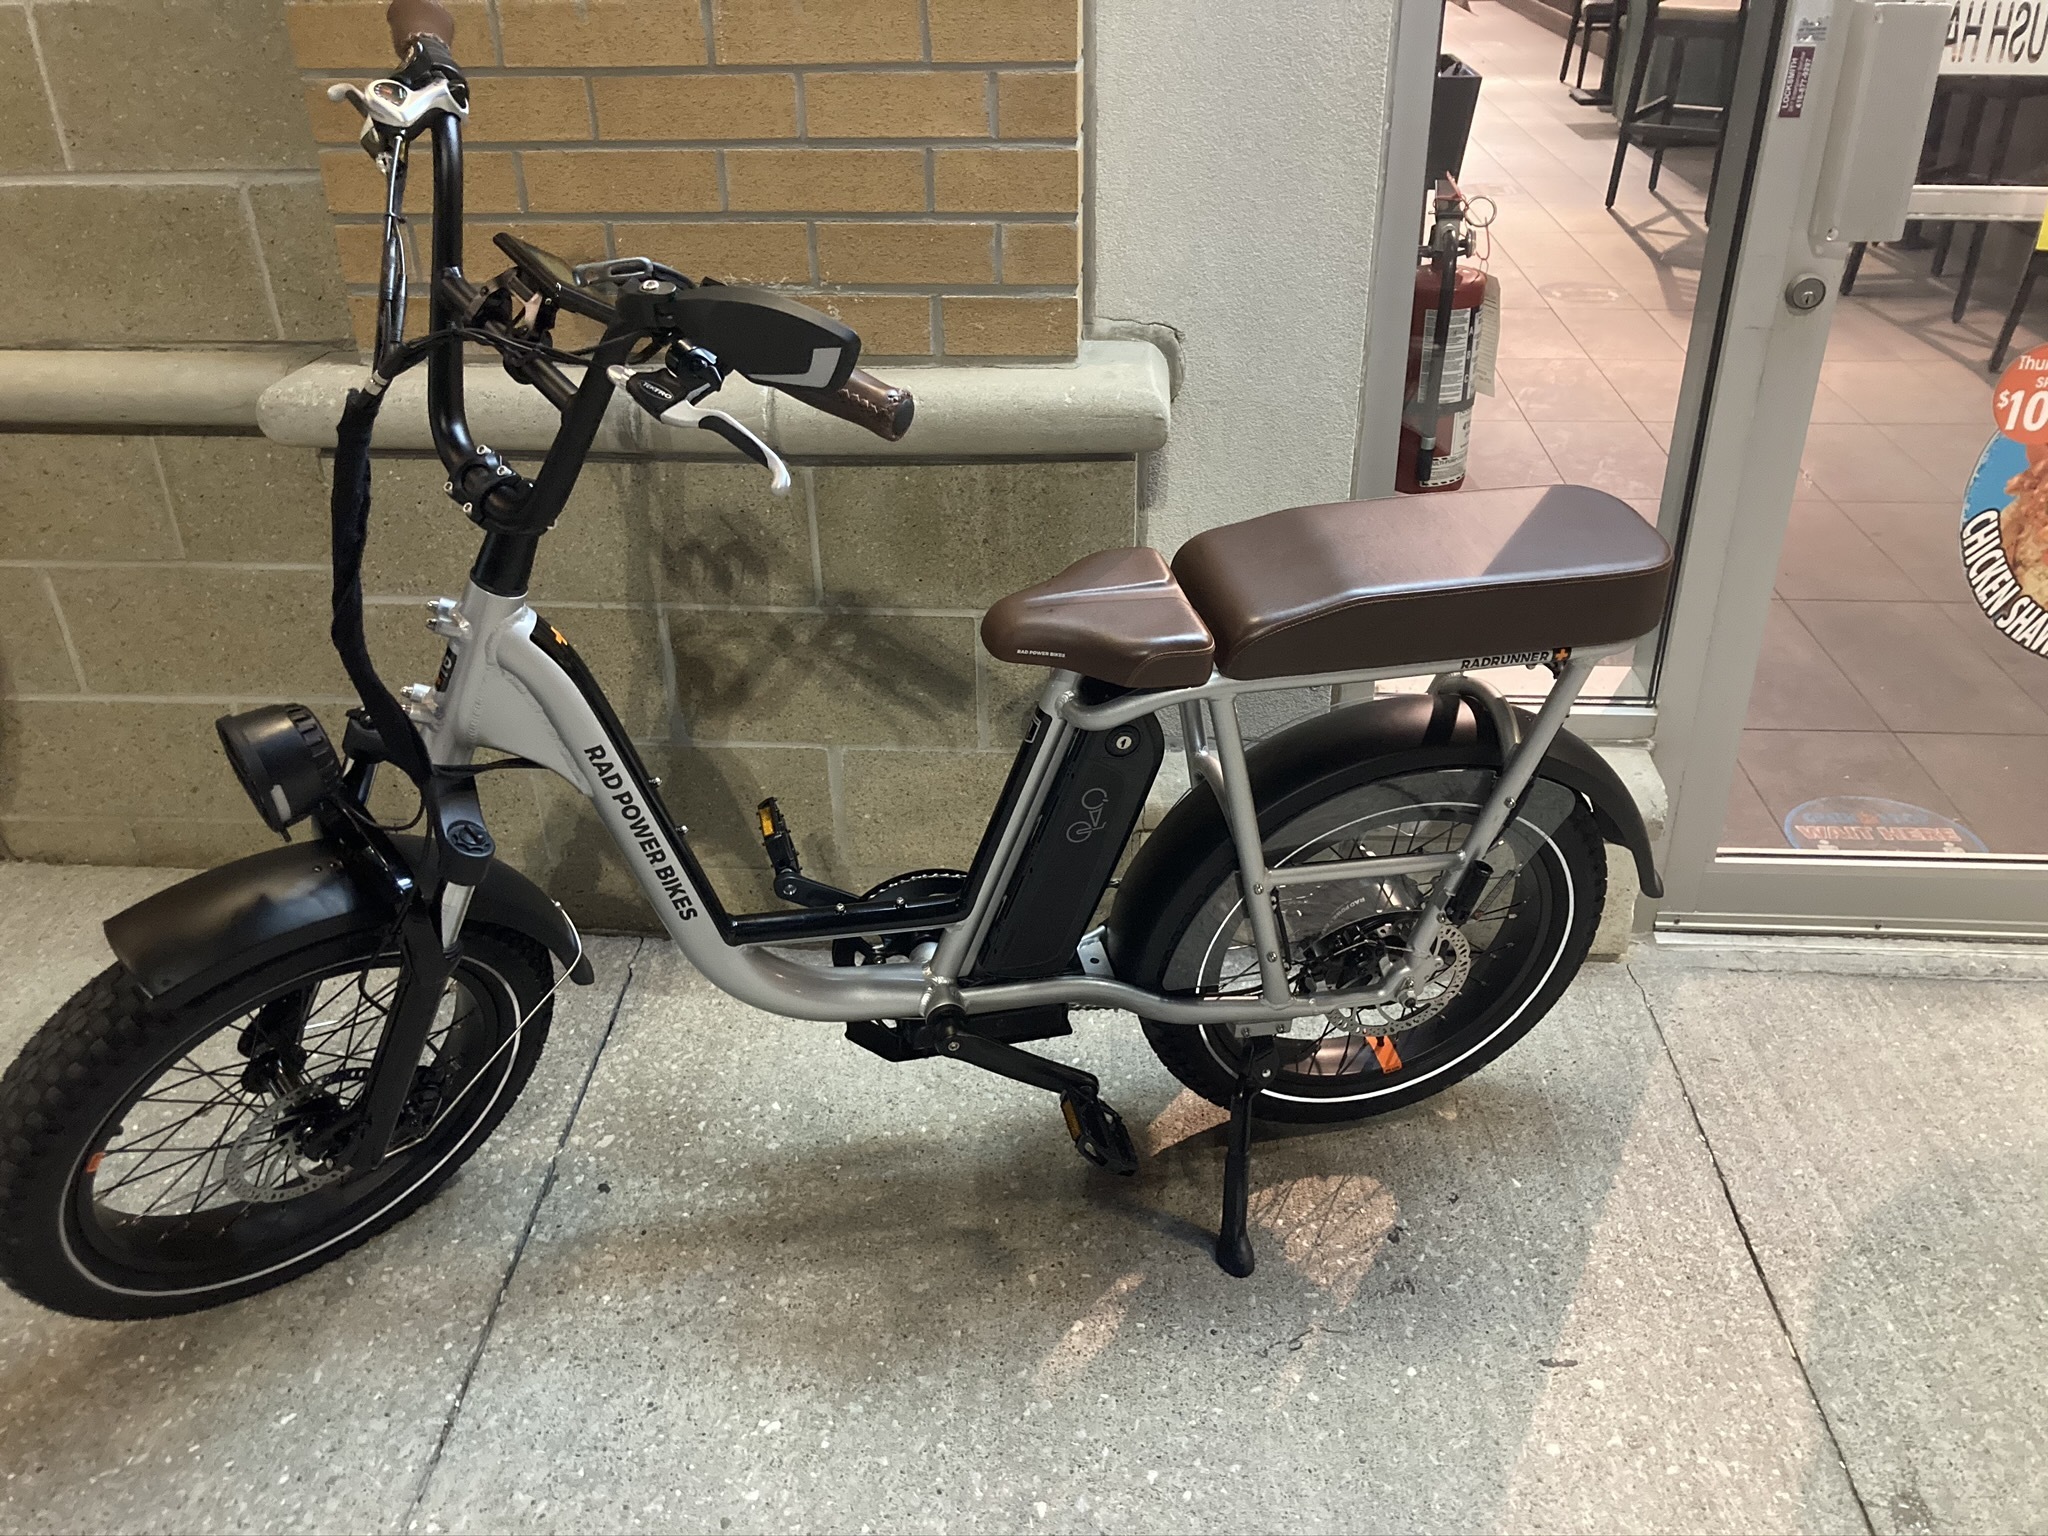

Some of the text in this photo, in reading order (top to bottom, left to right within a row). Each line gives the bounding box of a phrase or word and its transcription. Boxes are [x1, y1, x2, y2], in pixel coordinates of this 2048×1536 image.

[1782, 57, 1798, 109] LOCKSMITH
[643, 381, 672, 399] TEKTRO
[1996, 388, 2048, 432] $10
[1962, 509, 2022, 617] CHICKEN
[1460, 651, 1550, 670] RADRUNNER
[584, 744, 698, 921] RAD POWER BIKES
[1795, 825, 1962, 841] WAIT HERE
